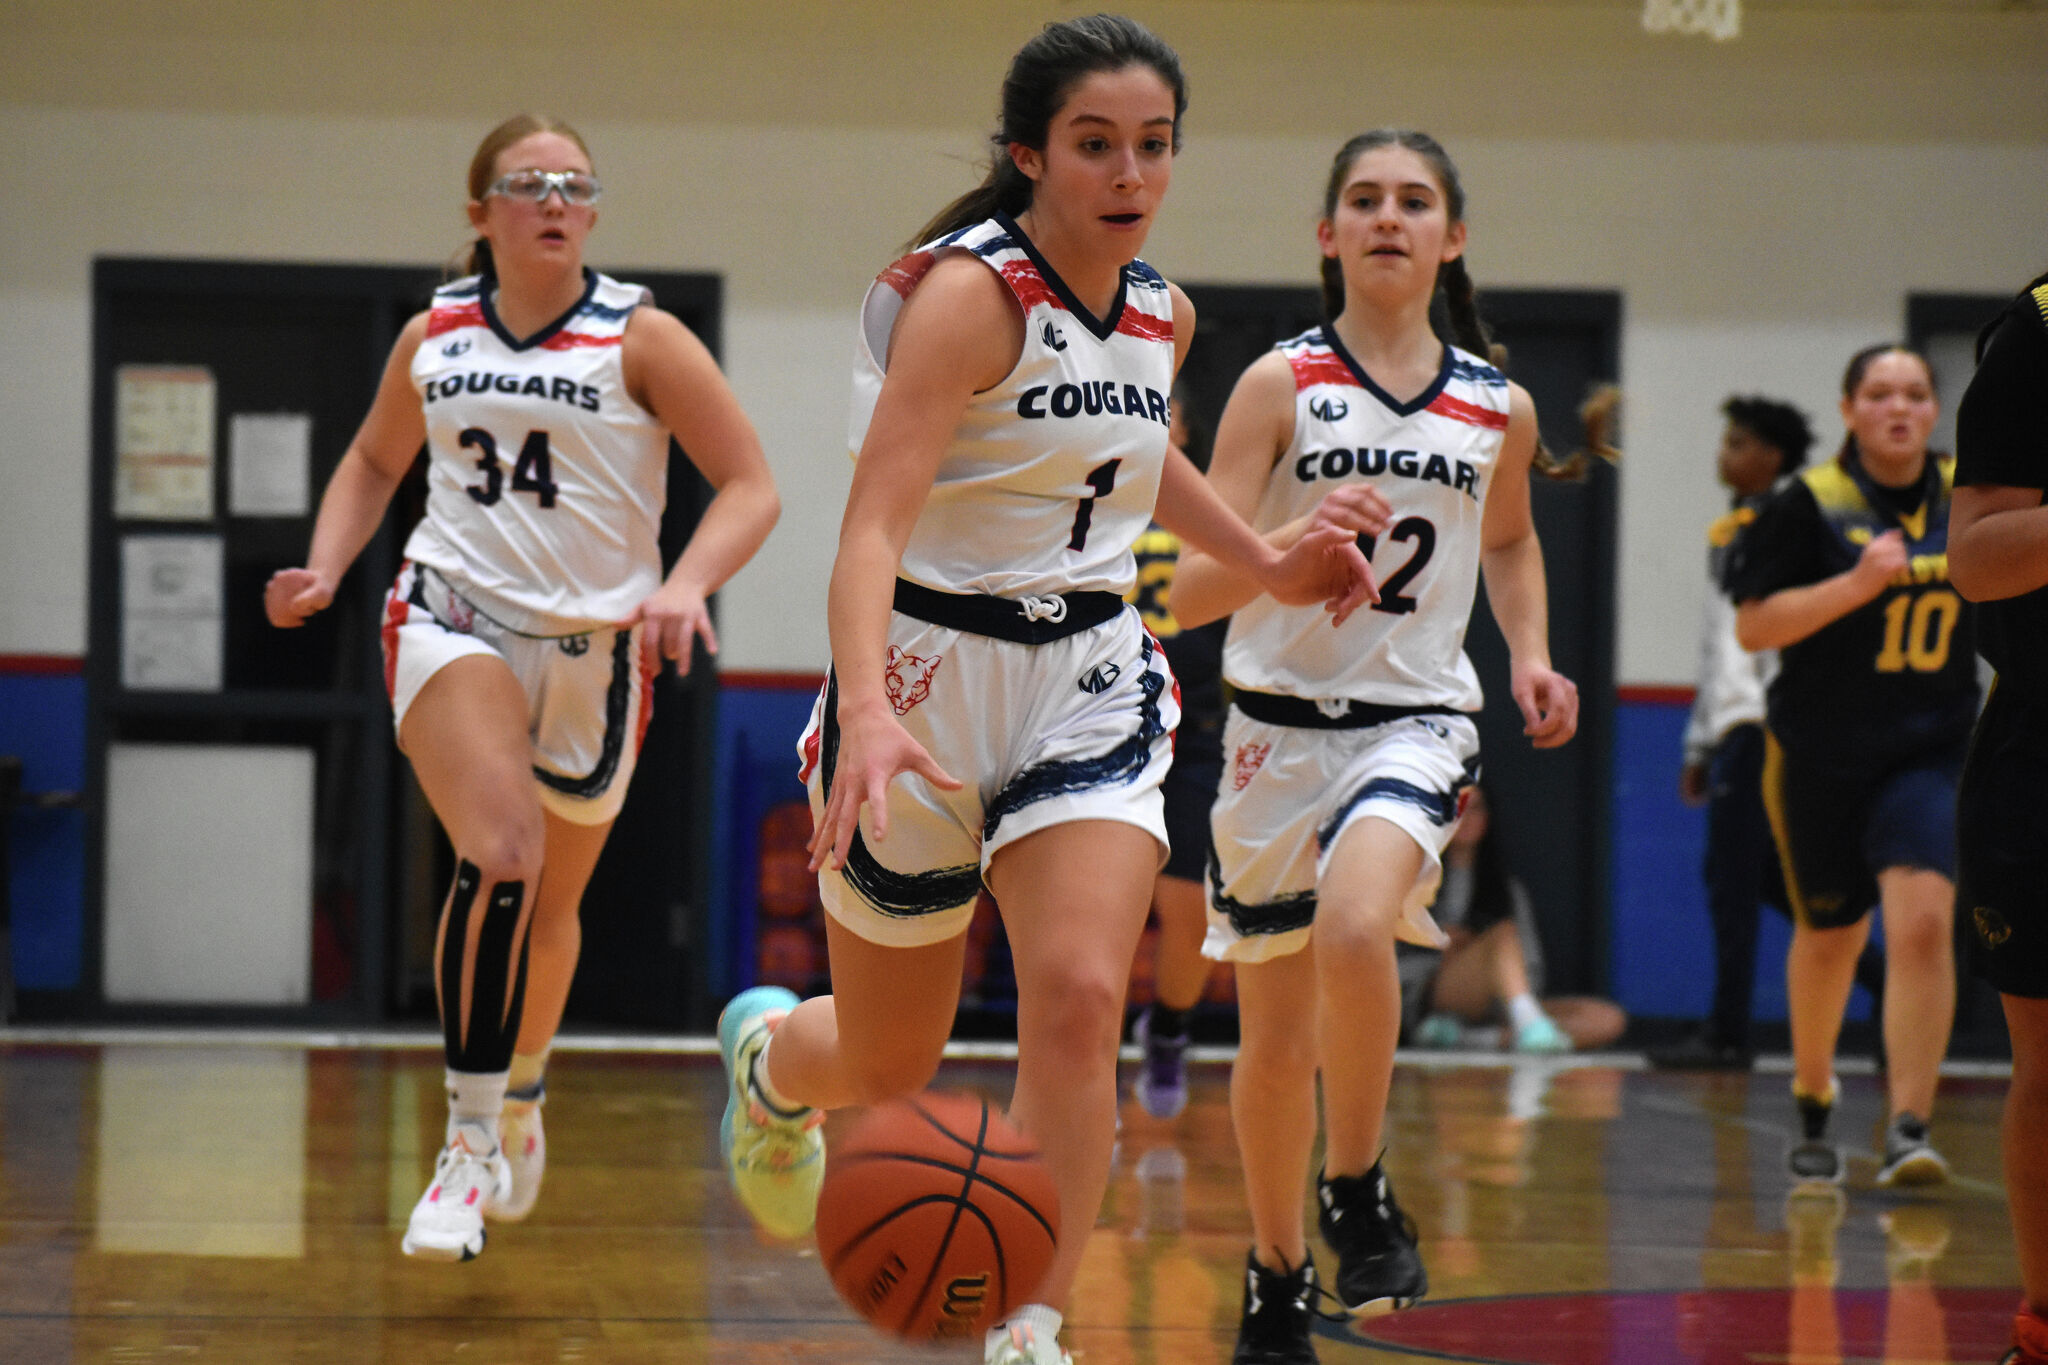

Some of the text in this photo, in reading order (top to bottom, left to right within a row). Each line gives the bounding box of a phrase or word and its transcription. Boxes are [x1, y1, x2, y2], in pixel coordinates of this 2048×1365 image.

[458, 427, 560, 509] 34
[1065, 457, 1123, 553] 1
[1295, 447, 1480, 502] COUGAR
[1875, 591, 1961, 672] 10
